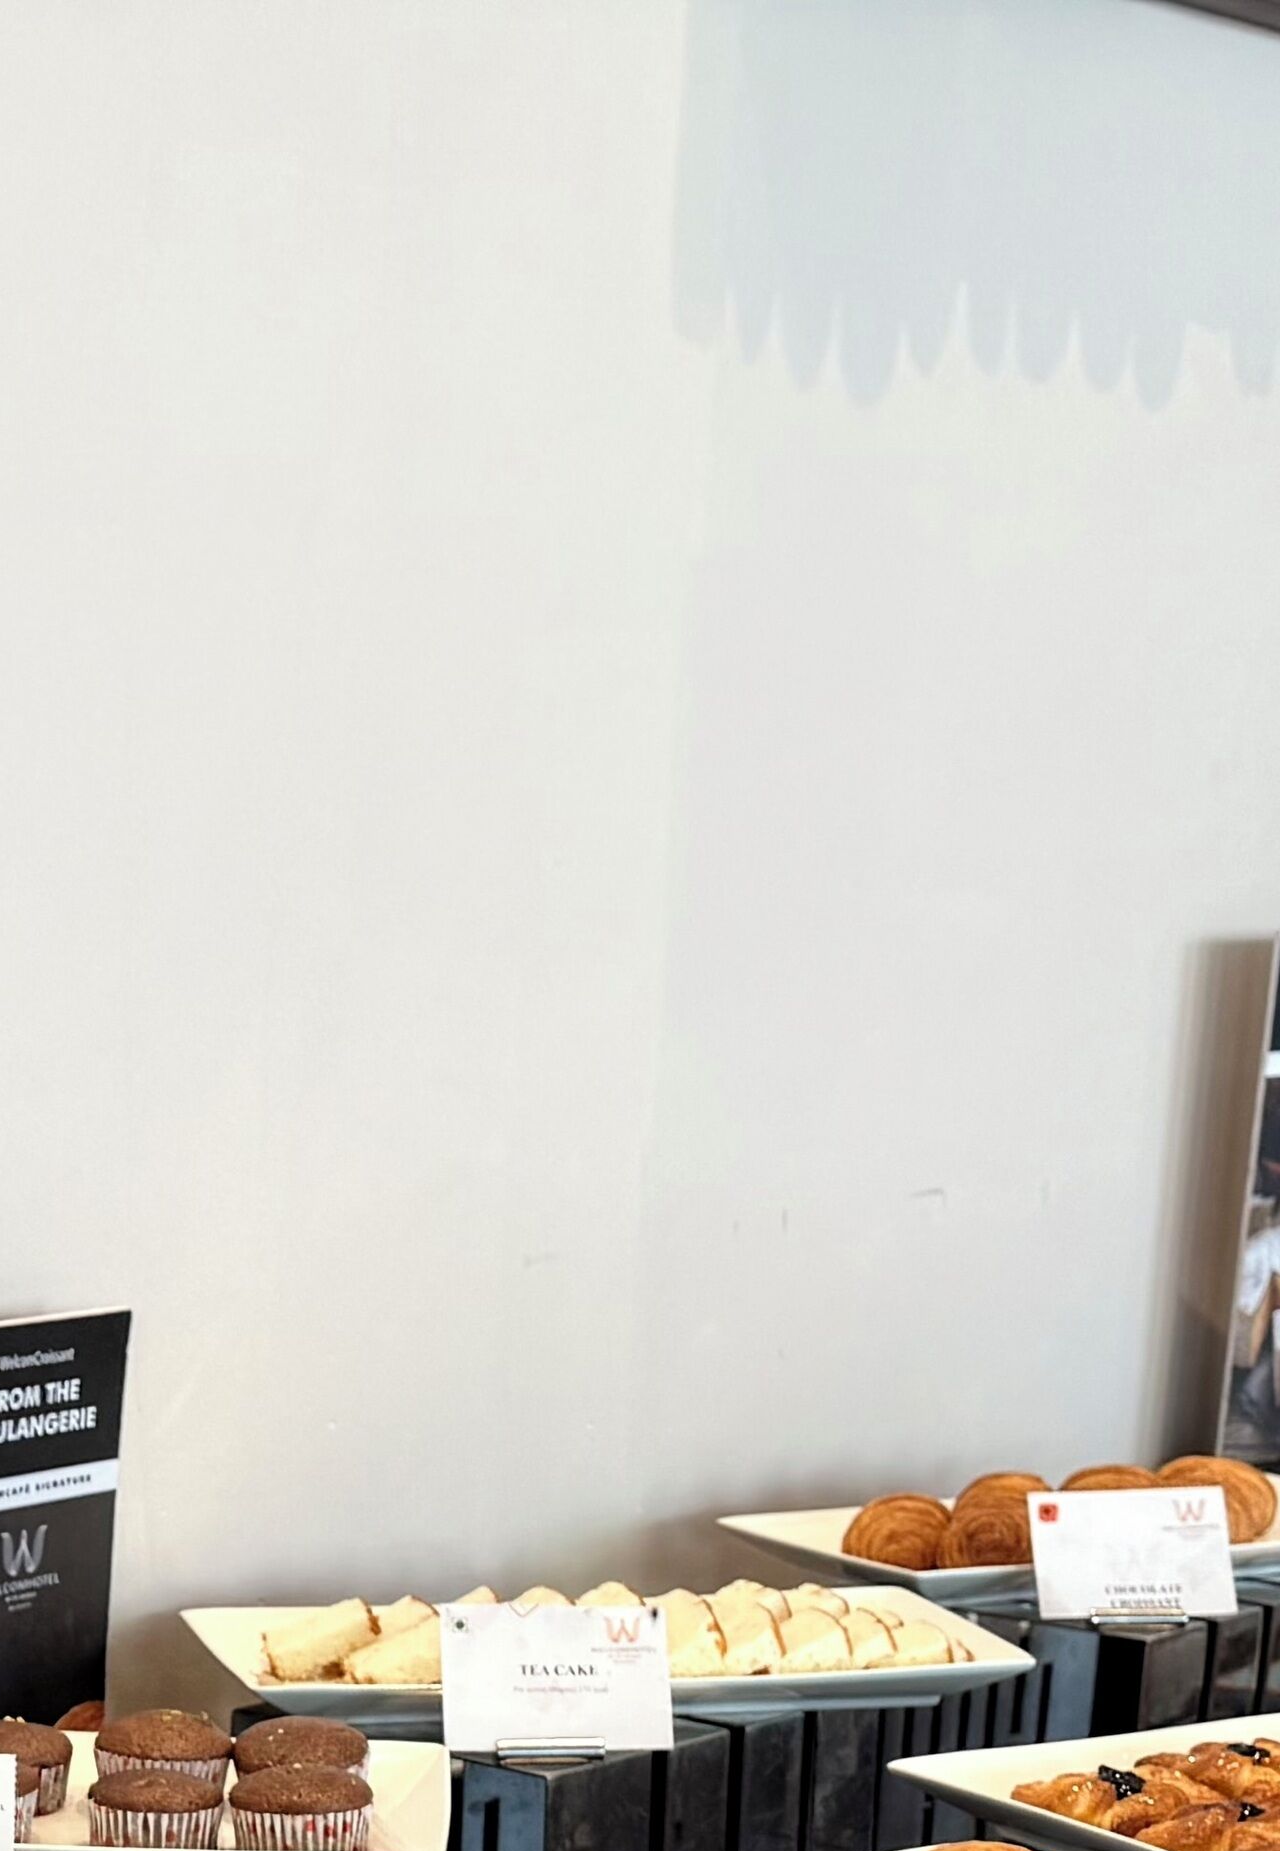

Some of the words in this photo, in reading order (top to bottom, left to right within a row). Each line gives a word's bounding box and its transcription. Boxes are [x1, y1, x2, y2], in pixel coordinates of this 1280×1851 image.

[45, 1378, 81, 1403] THE
[521, 1664, 549, 1676] TEA
[554, 1664, 599, 1676] CAKE
